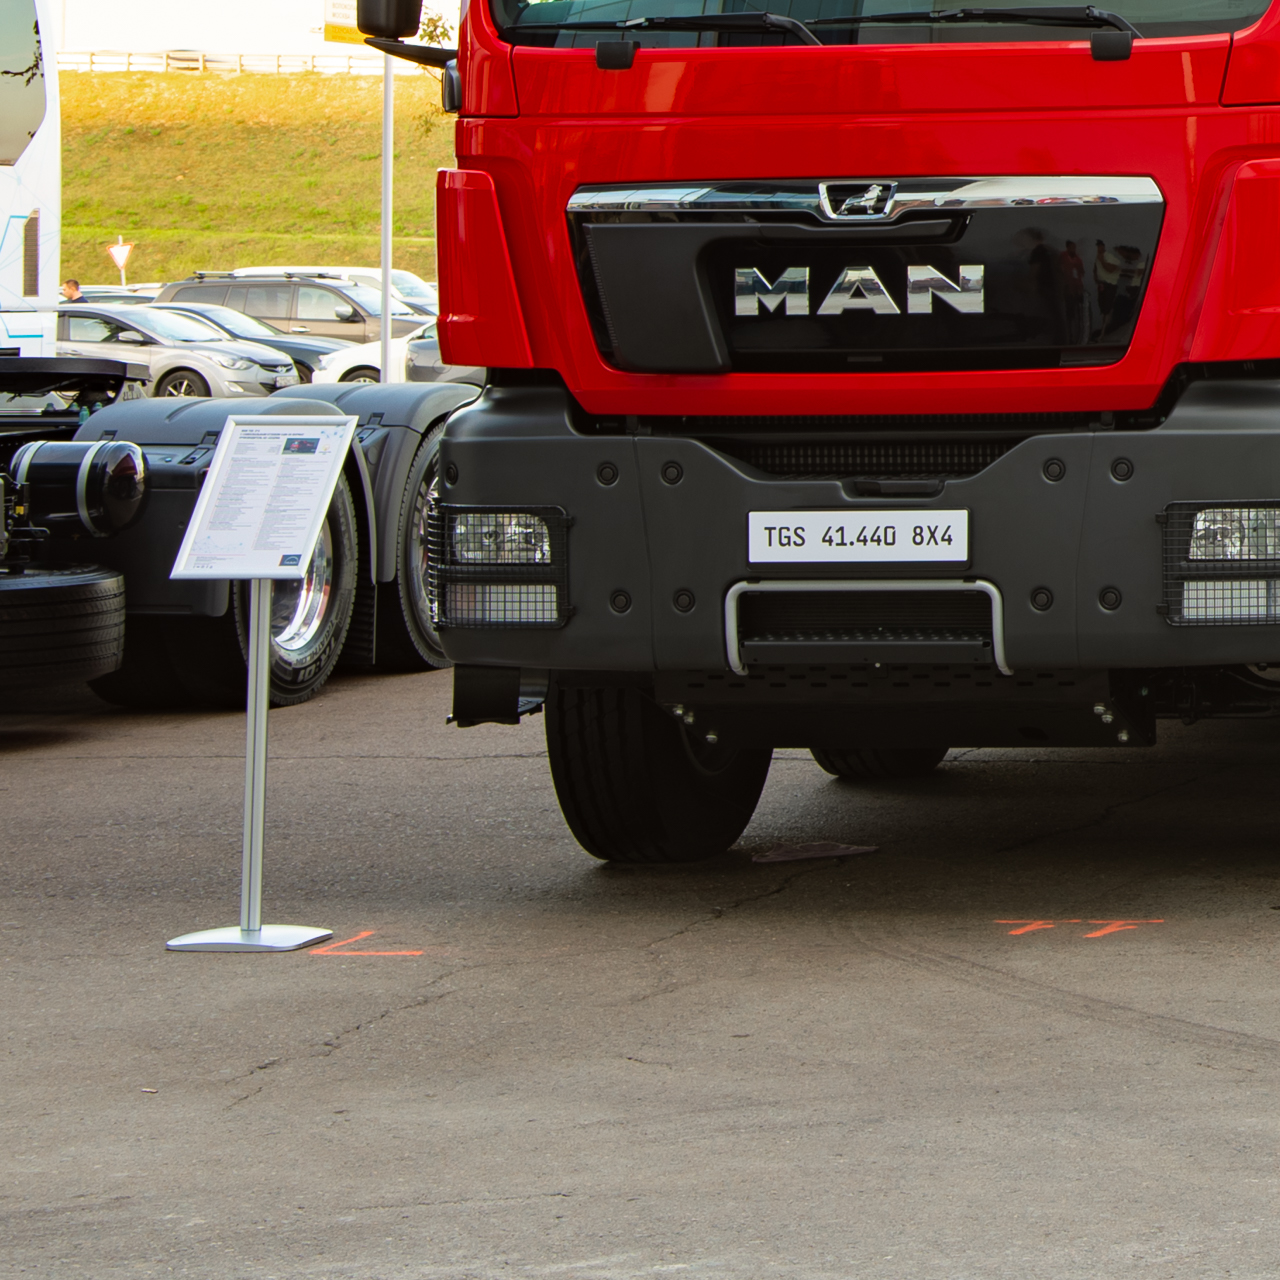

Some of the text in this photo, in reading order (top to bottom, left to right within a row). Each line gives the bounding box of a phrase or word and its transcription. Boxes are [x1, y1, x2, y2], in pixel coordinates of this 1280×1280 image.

[734, 264, 985, 316] MAN
[764, 525, 953, 548] TGS 41.440 8X4
